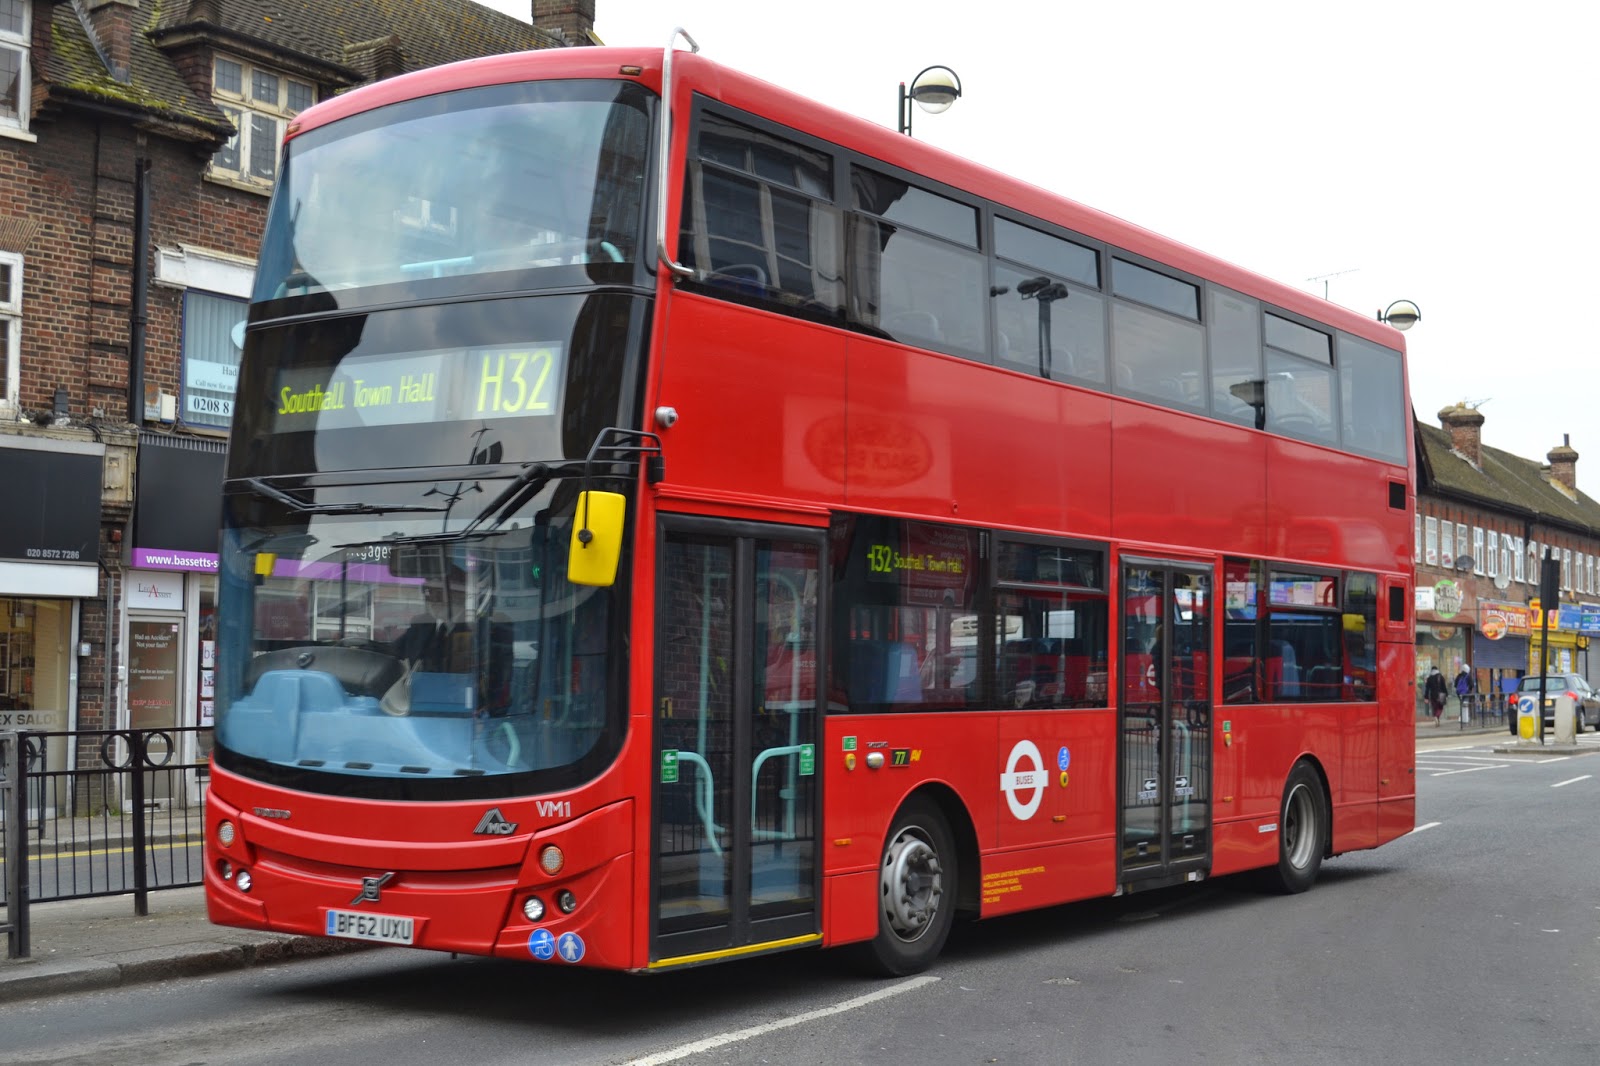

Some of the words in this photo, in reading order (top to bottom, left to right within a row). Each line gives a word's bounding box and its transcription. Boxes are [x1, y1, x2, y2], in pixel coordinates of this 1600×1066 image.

[222, 365, 237, 377] Had
[477, 347, 553, 412] H32
[278, 381, 345, 415] Southall
[353, 379, 392, 408] Town
[398, 373, 435, 404] Hall
[193, 397, 220, 413] 0208
[27, 548, 41, 558] 020
[42, 549, 61, 559] 8572
[61, 550, 80, 560] 7286
[146, 554, 219, 569] www.bassetts-s
[895, 751, 906, 765] 77
[1016, 775, 1034, 785] BUSES
[536, 800, 571, 818] VM1
[486, 822, 518, 834] MCV
[338, 914, 377, 936] BF62
[382, 918, 412, 940] UXU
